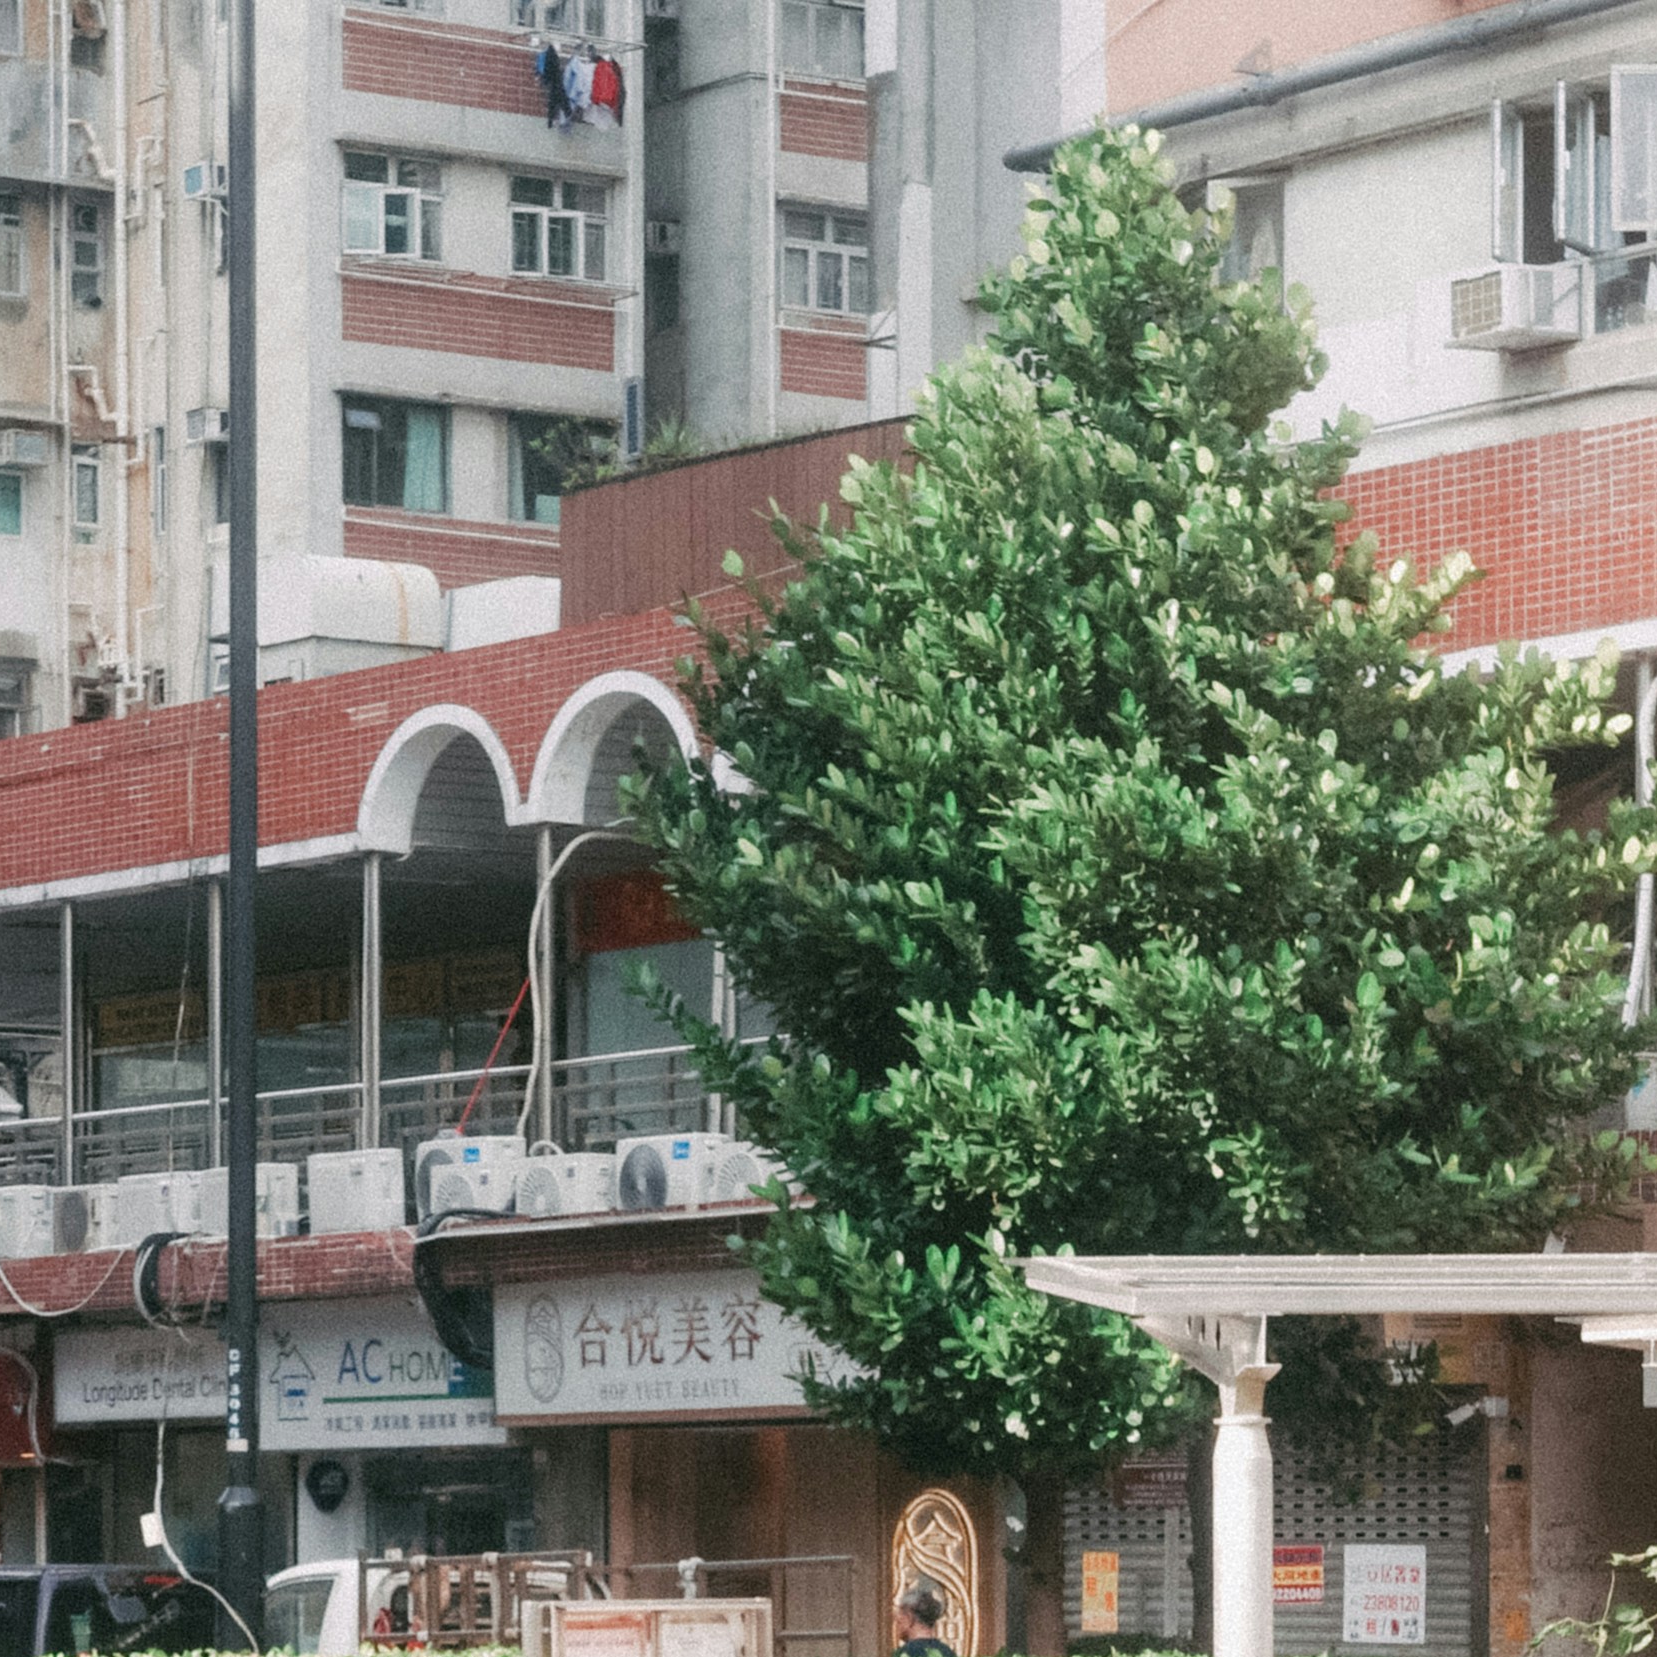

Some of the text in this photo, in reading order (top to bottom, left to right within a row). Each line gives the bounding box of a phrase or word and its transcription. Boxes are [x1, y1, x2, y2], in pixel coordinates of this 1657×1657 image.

[573, 1292, 765, 1369] 合悅美容
[337, 1339, 384, 1385] AC
[82, 1380, 149, 1408] Longitude
[682, 1378, 741, 1399] BEAUTY
